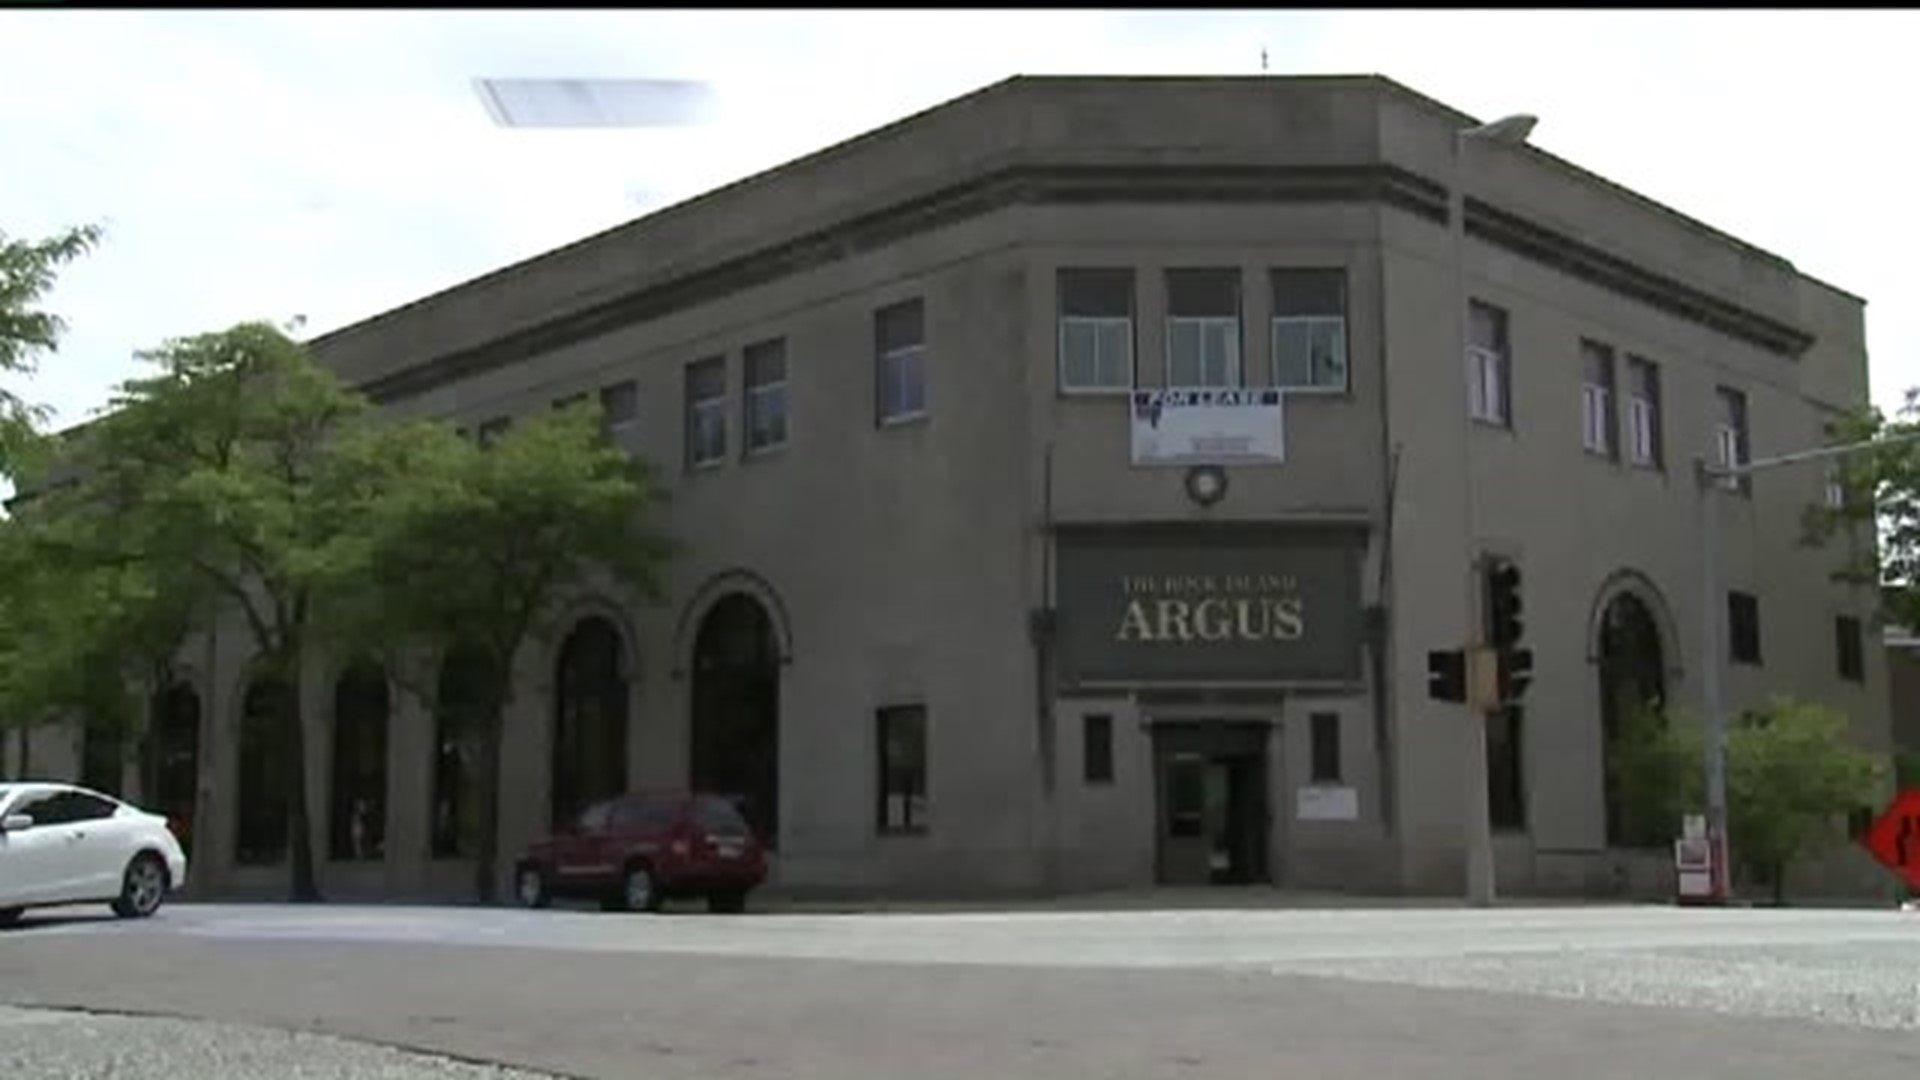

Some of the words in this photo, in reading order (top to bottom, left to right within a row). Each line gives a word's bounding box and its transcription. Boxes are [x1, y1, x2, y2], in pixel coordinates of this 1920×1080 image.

[1147, 390, 1190, 406] FOR
[1196, 390, 1263, 405] LEASE
[1121, 574, 1157, 592] THE
[1163, 574, 1215, 593] ROCK
[1224, 574, 1298, 592] ISLAND
[1115, 597, 1303, 642] ARGUS
